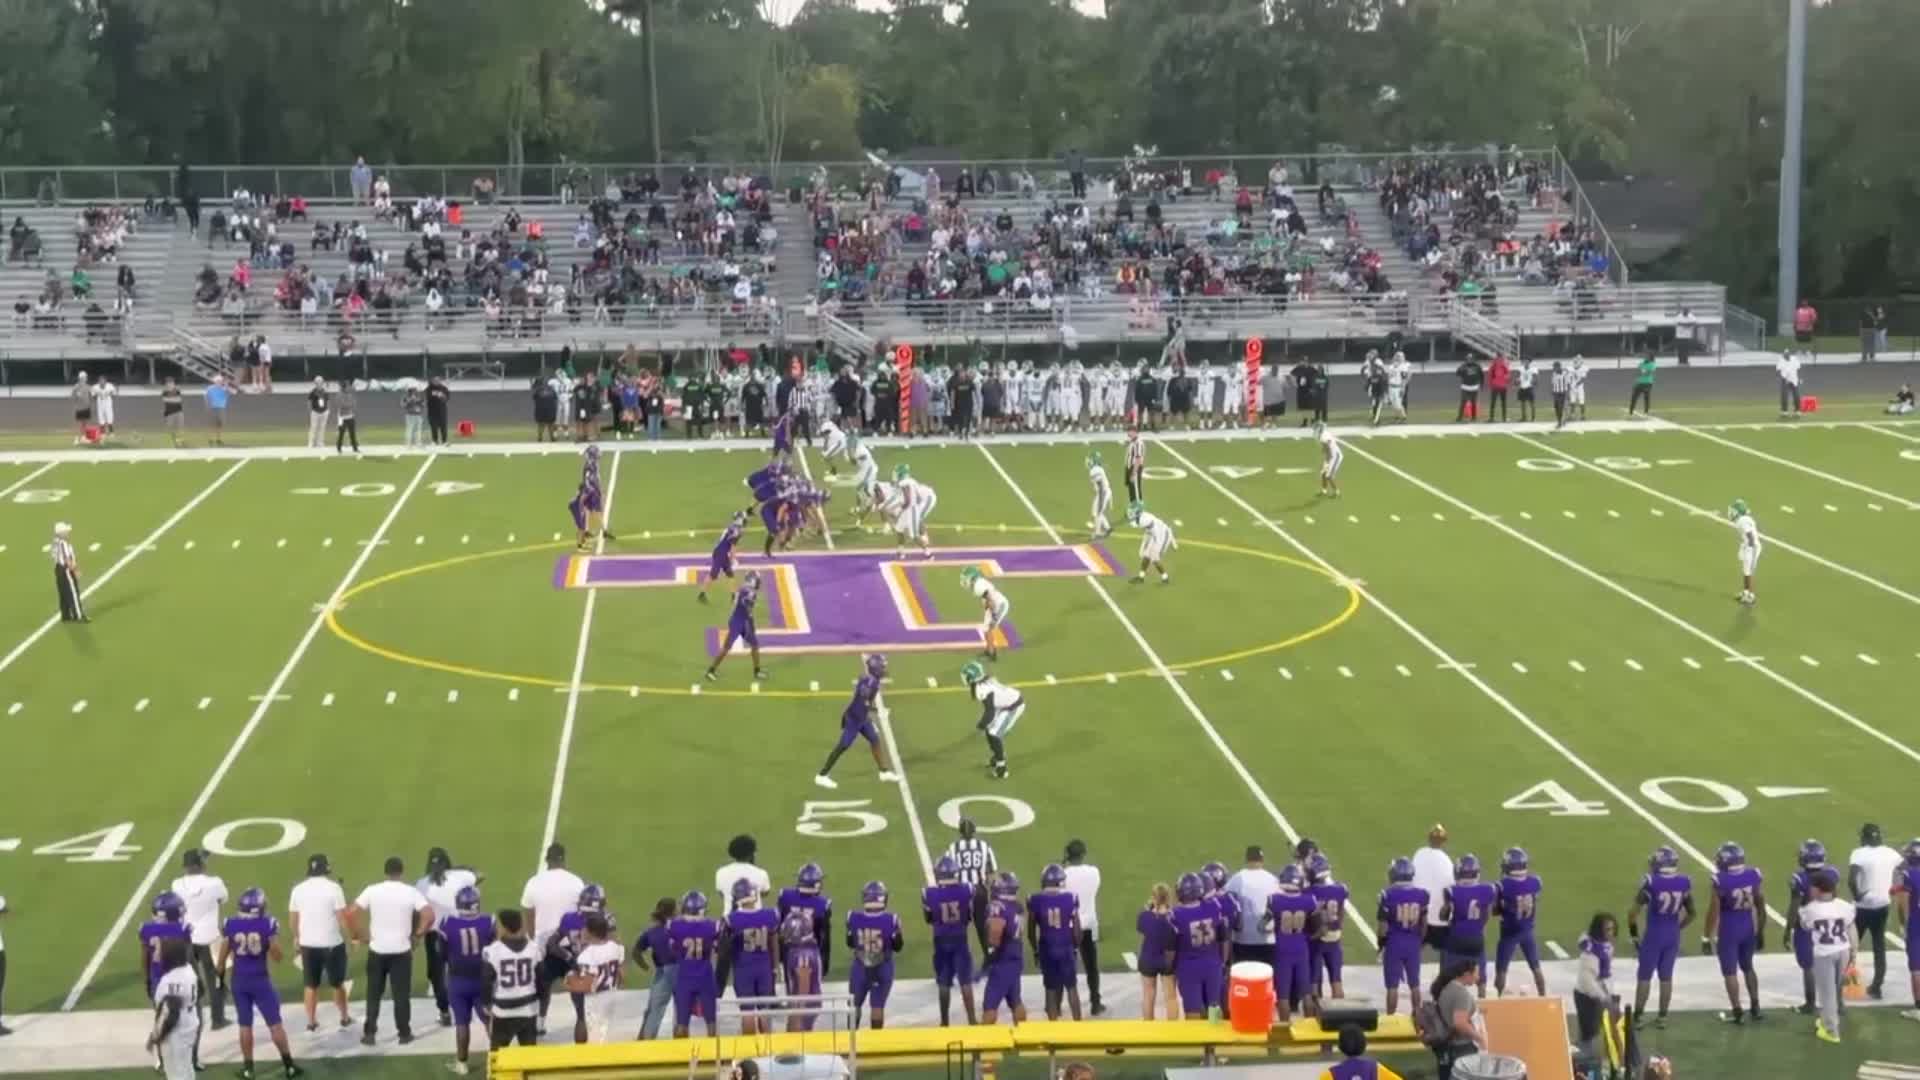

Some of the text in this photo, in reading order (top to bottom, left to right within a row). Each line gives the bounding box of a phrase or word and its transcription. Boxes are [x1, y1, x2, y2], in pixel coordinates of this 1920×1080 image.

[1502, 776, 1749, 816] 40
[795, 794, 1036, 838] 50
[33, 817, 307, 862] 40
[956, 850, 982, 869] 136
[459, 927, 479, 956] 11
[499, 957, 532, 988] 50
